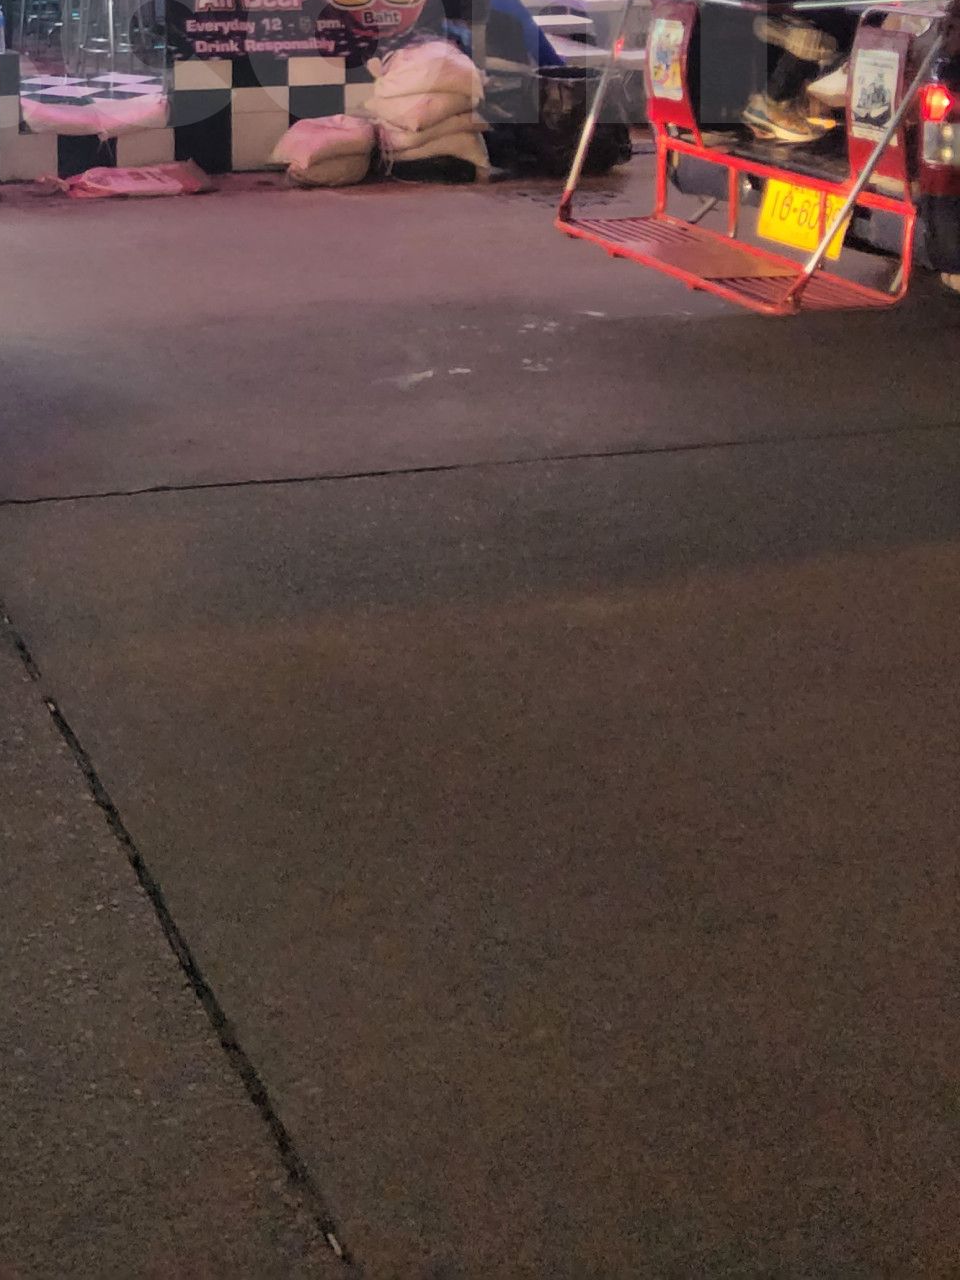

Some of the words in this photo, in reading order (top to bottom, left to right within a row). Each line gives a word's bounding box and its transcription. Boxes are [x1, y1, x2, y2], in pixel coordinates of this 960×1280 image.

[186, 19, 255, 35] Everyday
[262, 18, 283, 31] 12
[363, 12, 401, 26] Baht
[195, 40, 239, 53] Drink
[244, 37, 336, 53] Responsibly
